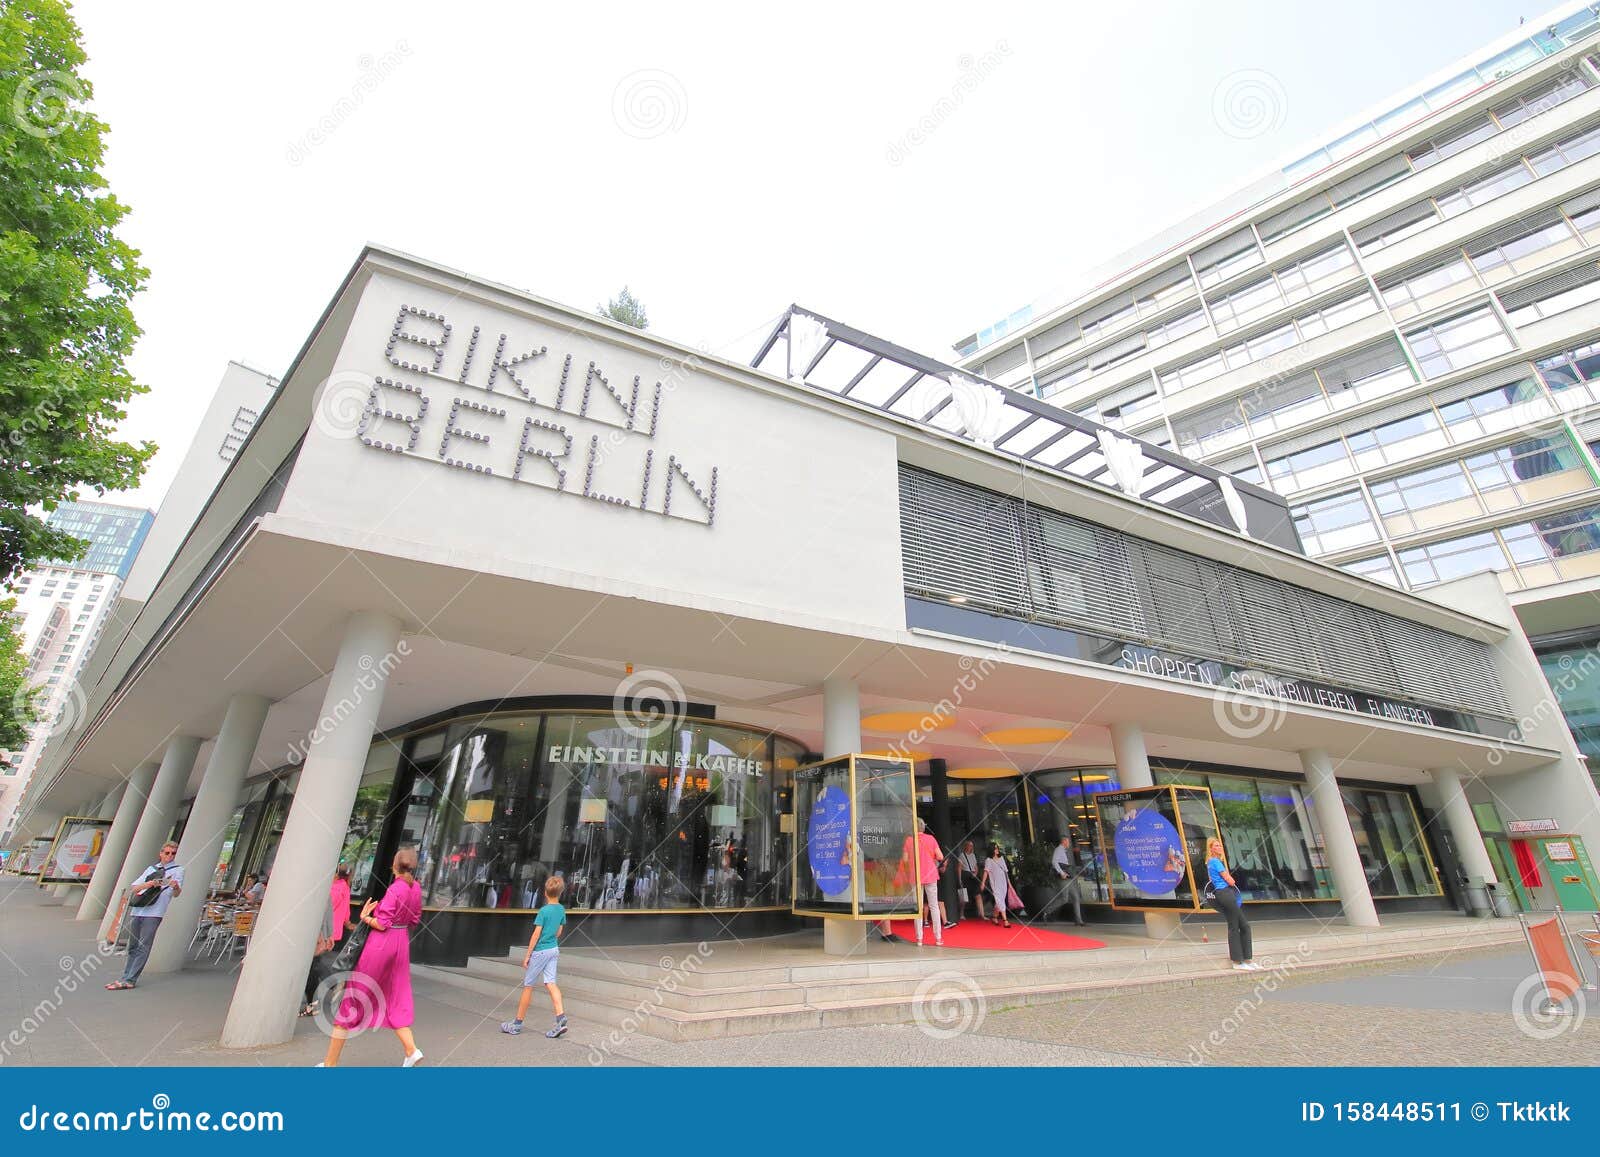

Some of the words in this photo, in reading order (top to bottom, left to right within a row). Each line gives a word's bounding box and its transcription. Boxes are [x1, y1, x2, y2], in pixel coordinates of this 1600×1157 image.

[385, 304, 662, 440] BIKINI
[357, 376, 718, 527] BERLIN
[1121, 650, 1214, 686] SHOPPEN
[548, 746, 670, 768] EINSTEIN
[696, 753, 764, 778] KAFFEE
[862, 834, 889, 846] BERLIN
